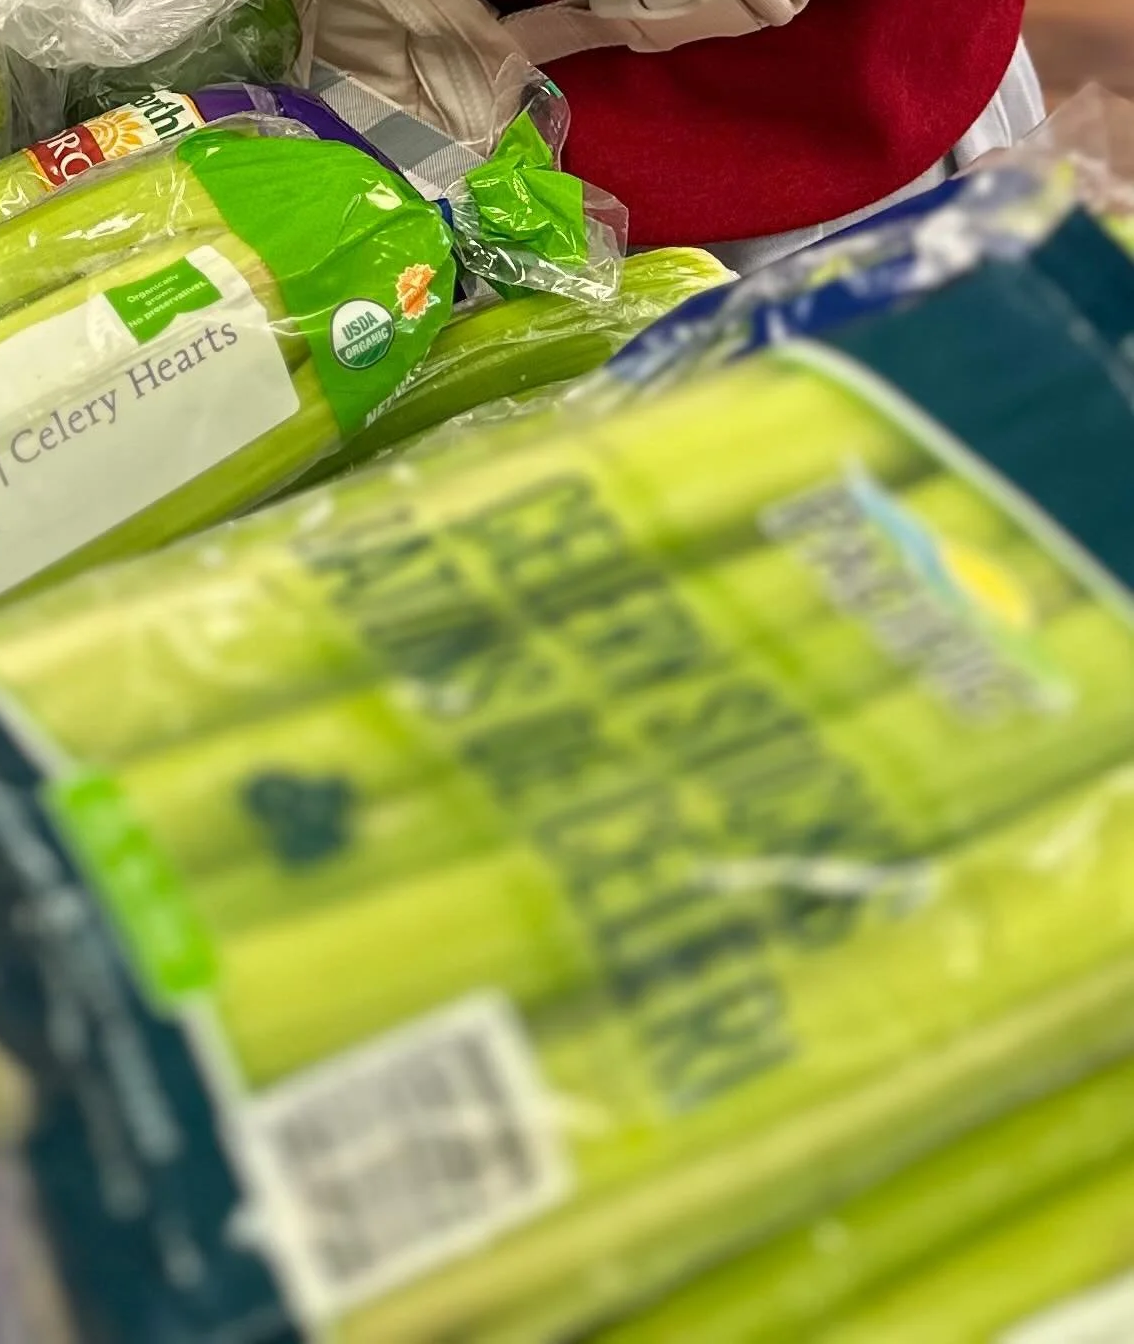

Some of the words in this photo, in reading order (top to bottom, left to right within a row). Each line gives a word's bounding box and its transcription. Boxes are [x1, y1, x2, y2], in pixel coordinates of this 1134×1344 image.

[127, 274, 179, 303] Organically
[128, 317, 144, 328] No
[341, 311, 376, 340] USDA
[344, 327, 390, 361] ORGANIC
[10, 388, 119, 464] Celery
[124, 321, 239, 400] Hearts
[466, 467, 726, 707] CELERY
